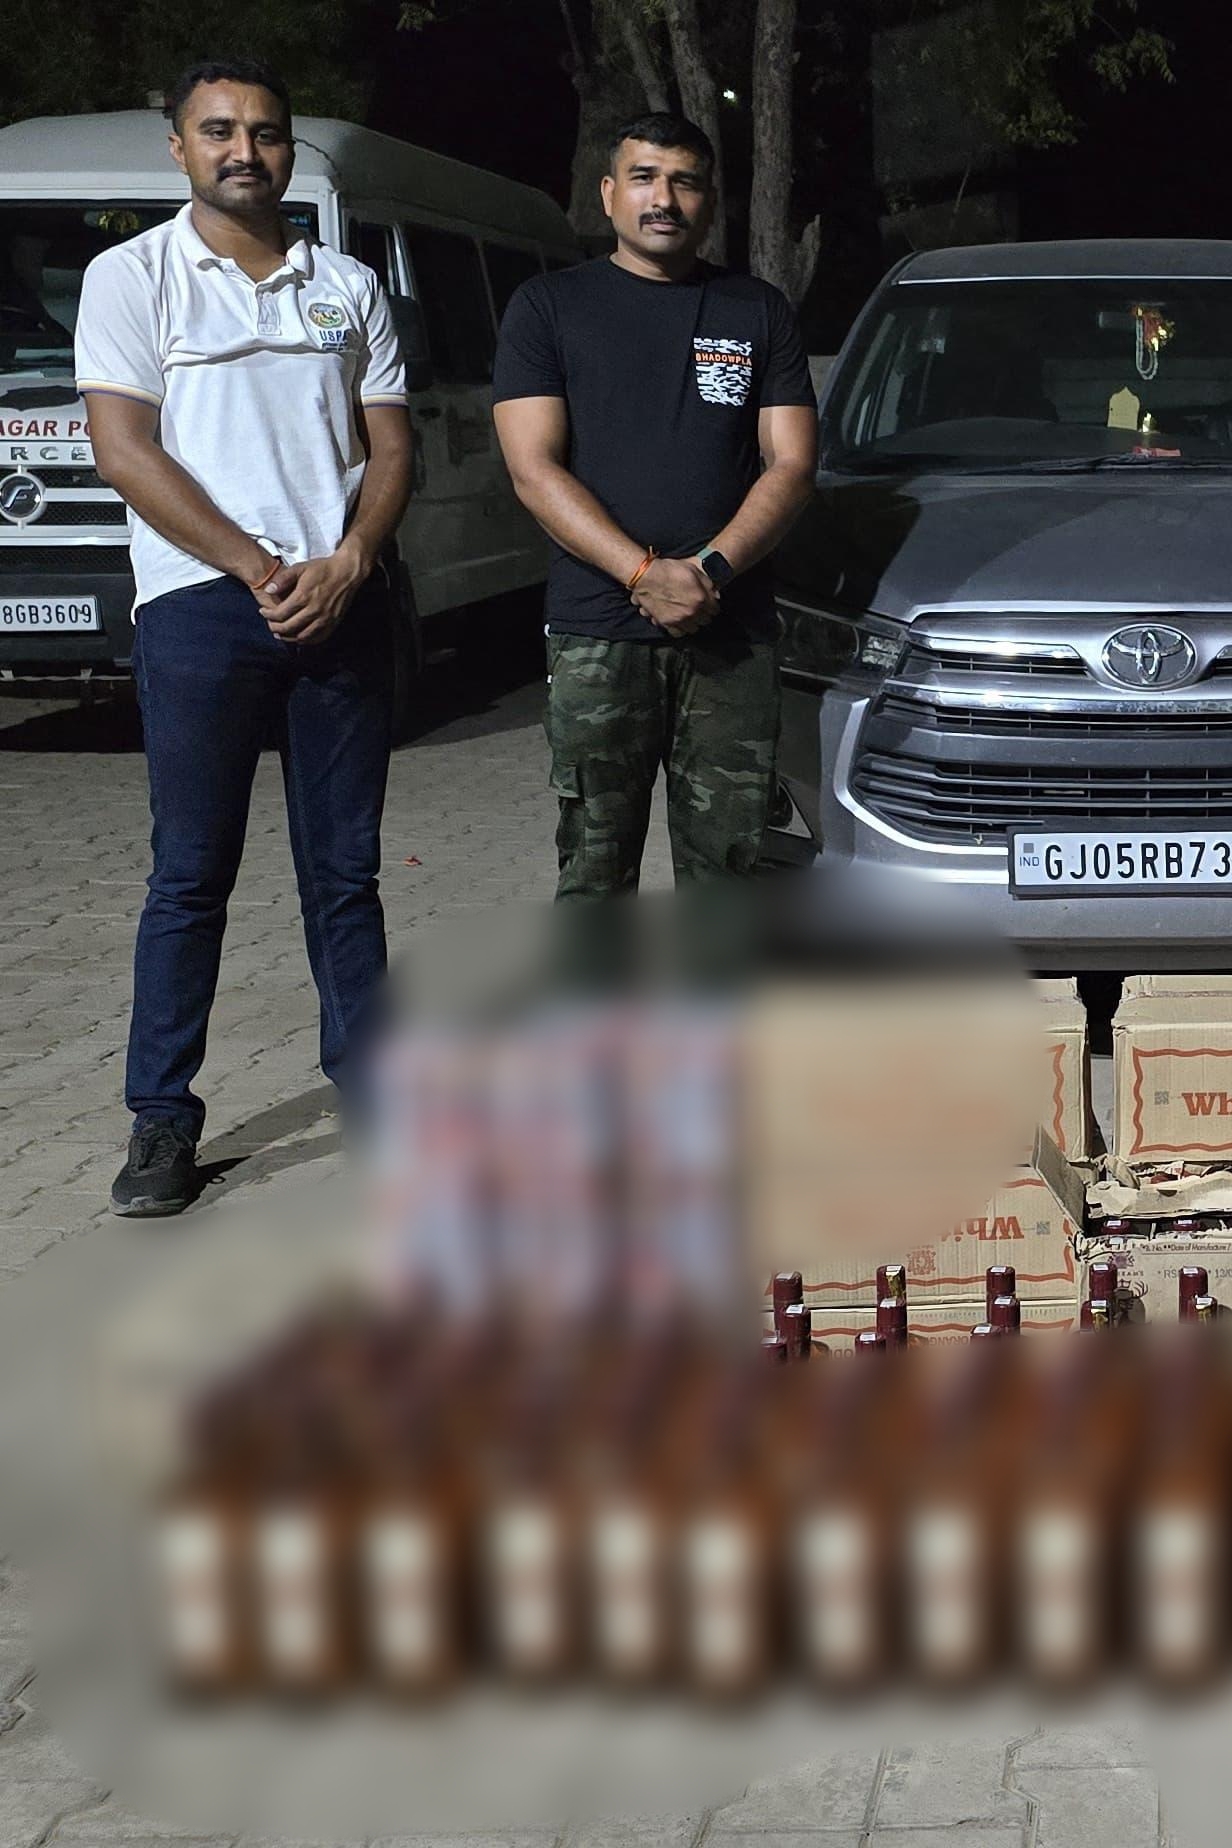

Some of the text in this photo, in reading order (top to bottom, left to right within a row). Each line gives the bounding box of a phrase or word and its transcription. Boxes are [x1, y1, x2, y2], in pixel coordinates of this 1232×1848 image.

[2, 604, 92, 624] 8GB3609
[1019, 856, 1039, 867] IND
[927, 1334, 970, 1347] ORANG
